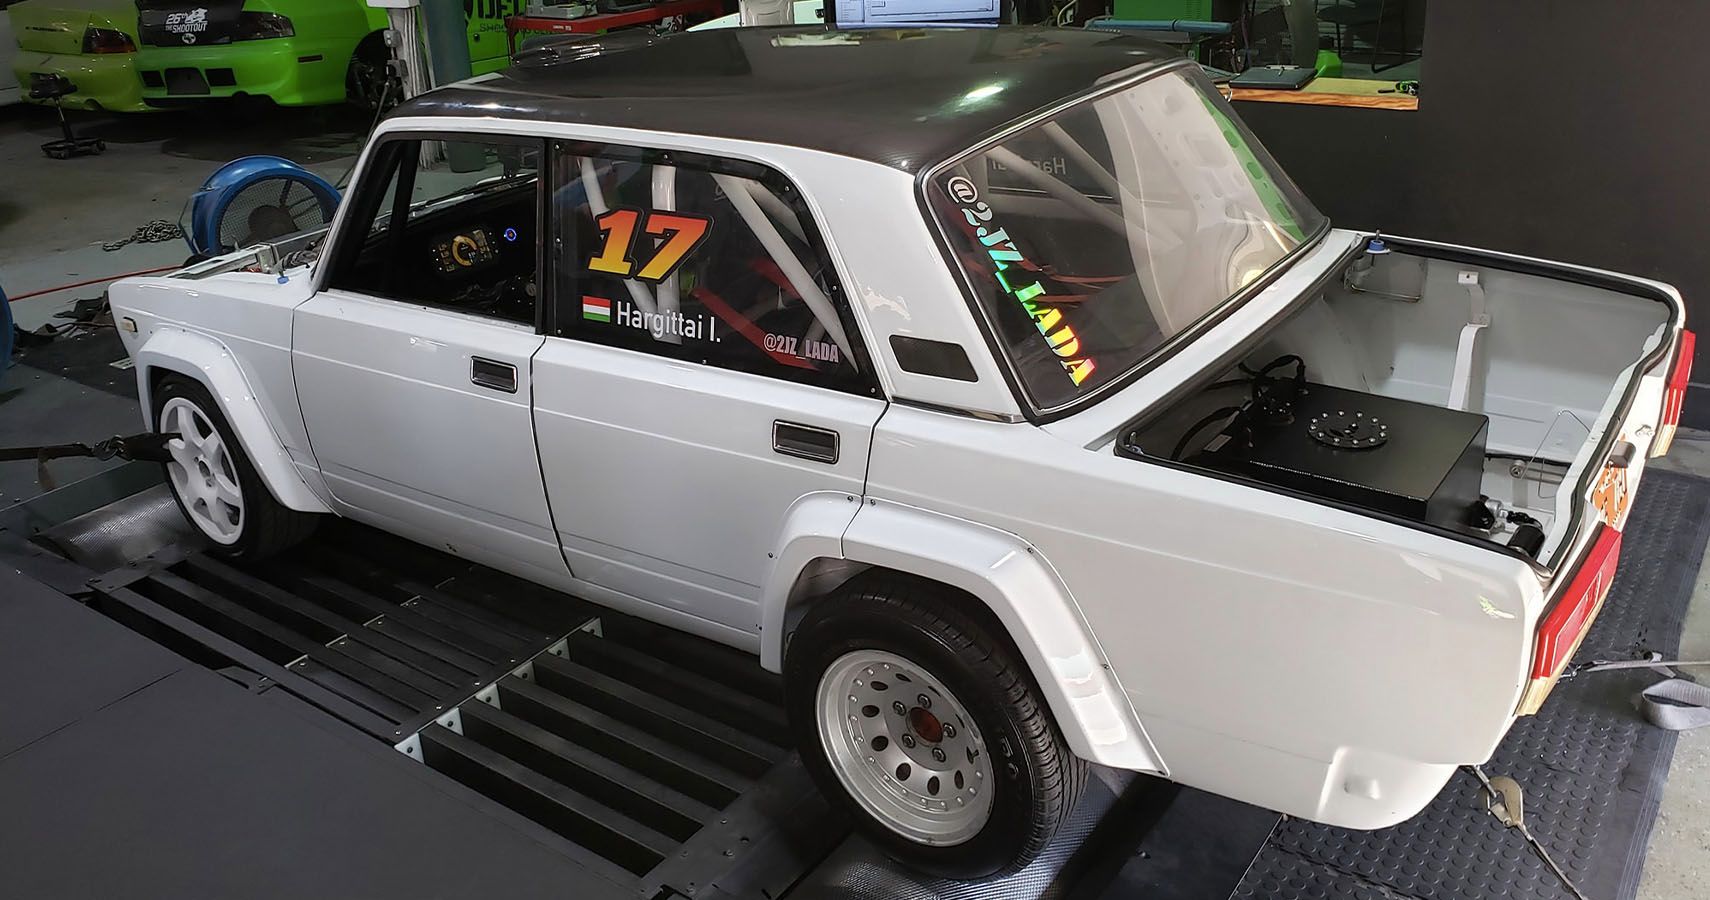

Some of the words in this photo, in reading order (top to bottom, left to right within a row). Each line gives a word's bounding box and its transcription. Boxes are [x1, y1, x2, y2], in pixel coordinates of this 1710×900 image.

[172, 22, 208, 33] SHOOTOUT
[587, 209, 711, 282] 17
[948, 176, 1096, 387] @2JZ_LADA
[617, 301, 703, 339] Hargittai
[763, 333, 839, 363] @2JZ_LADA
